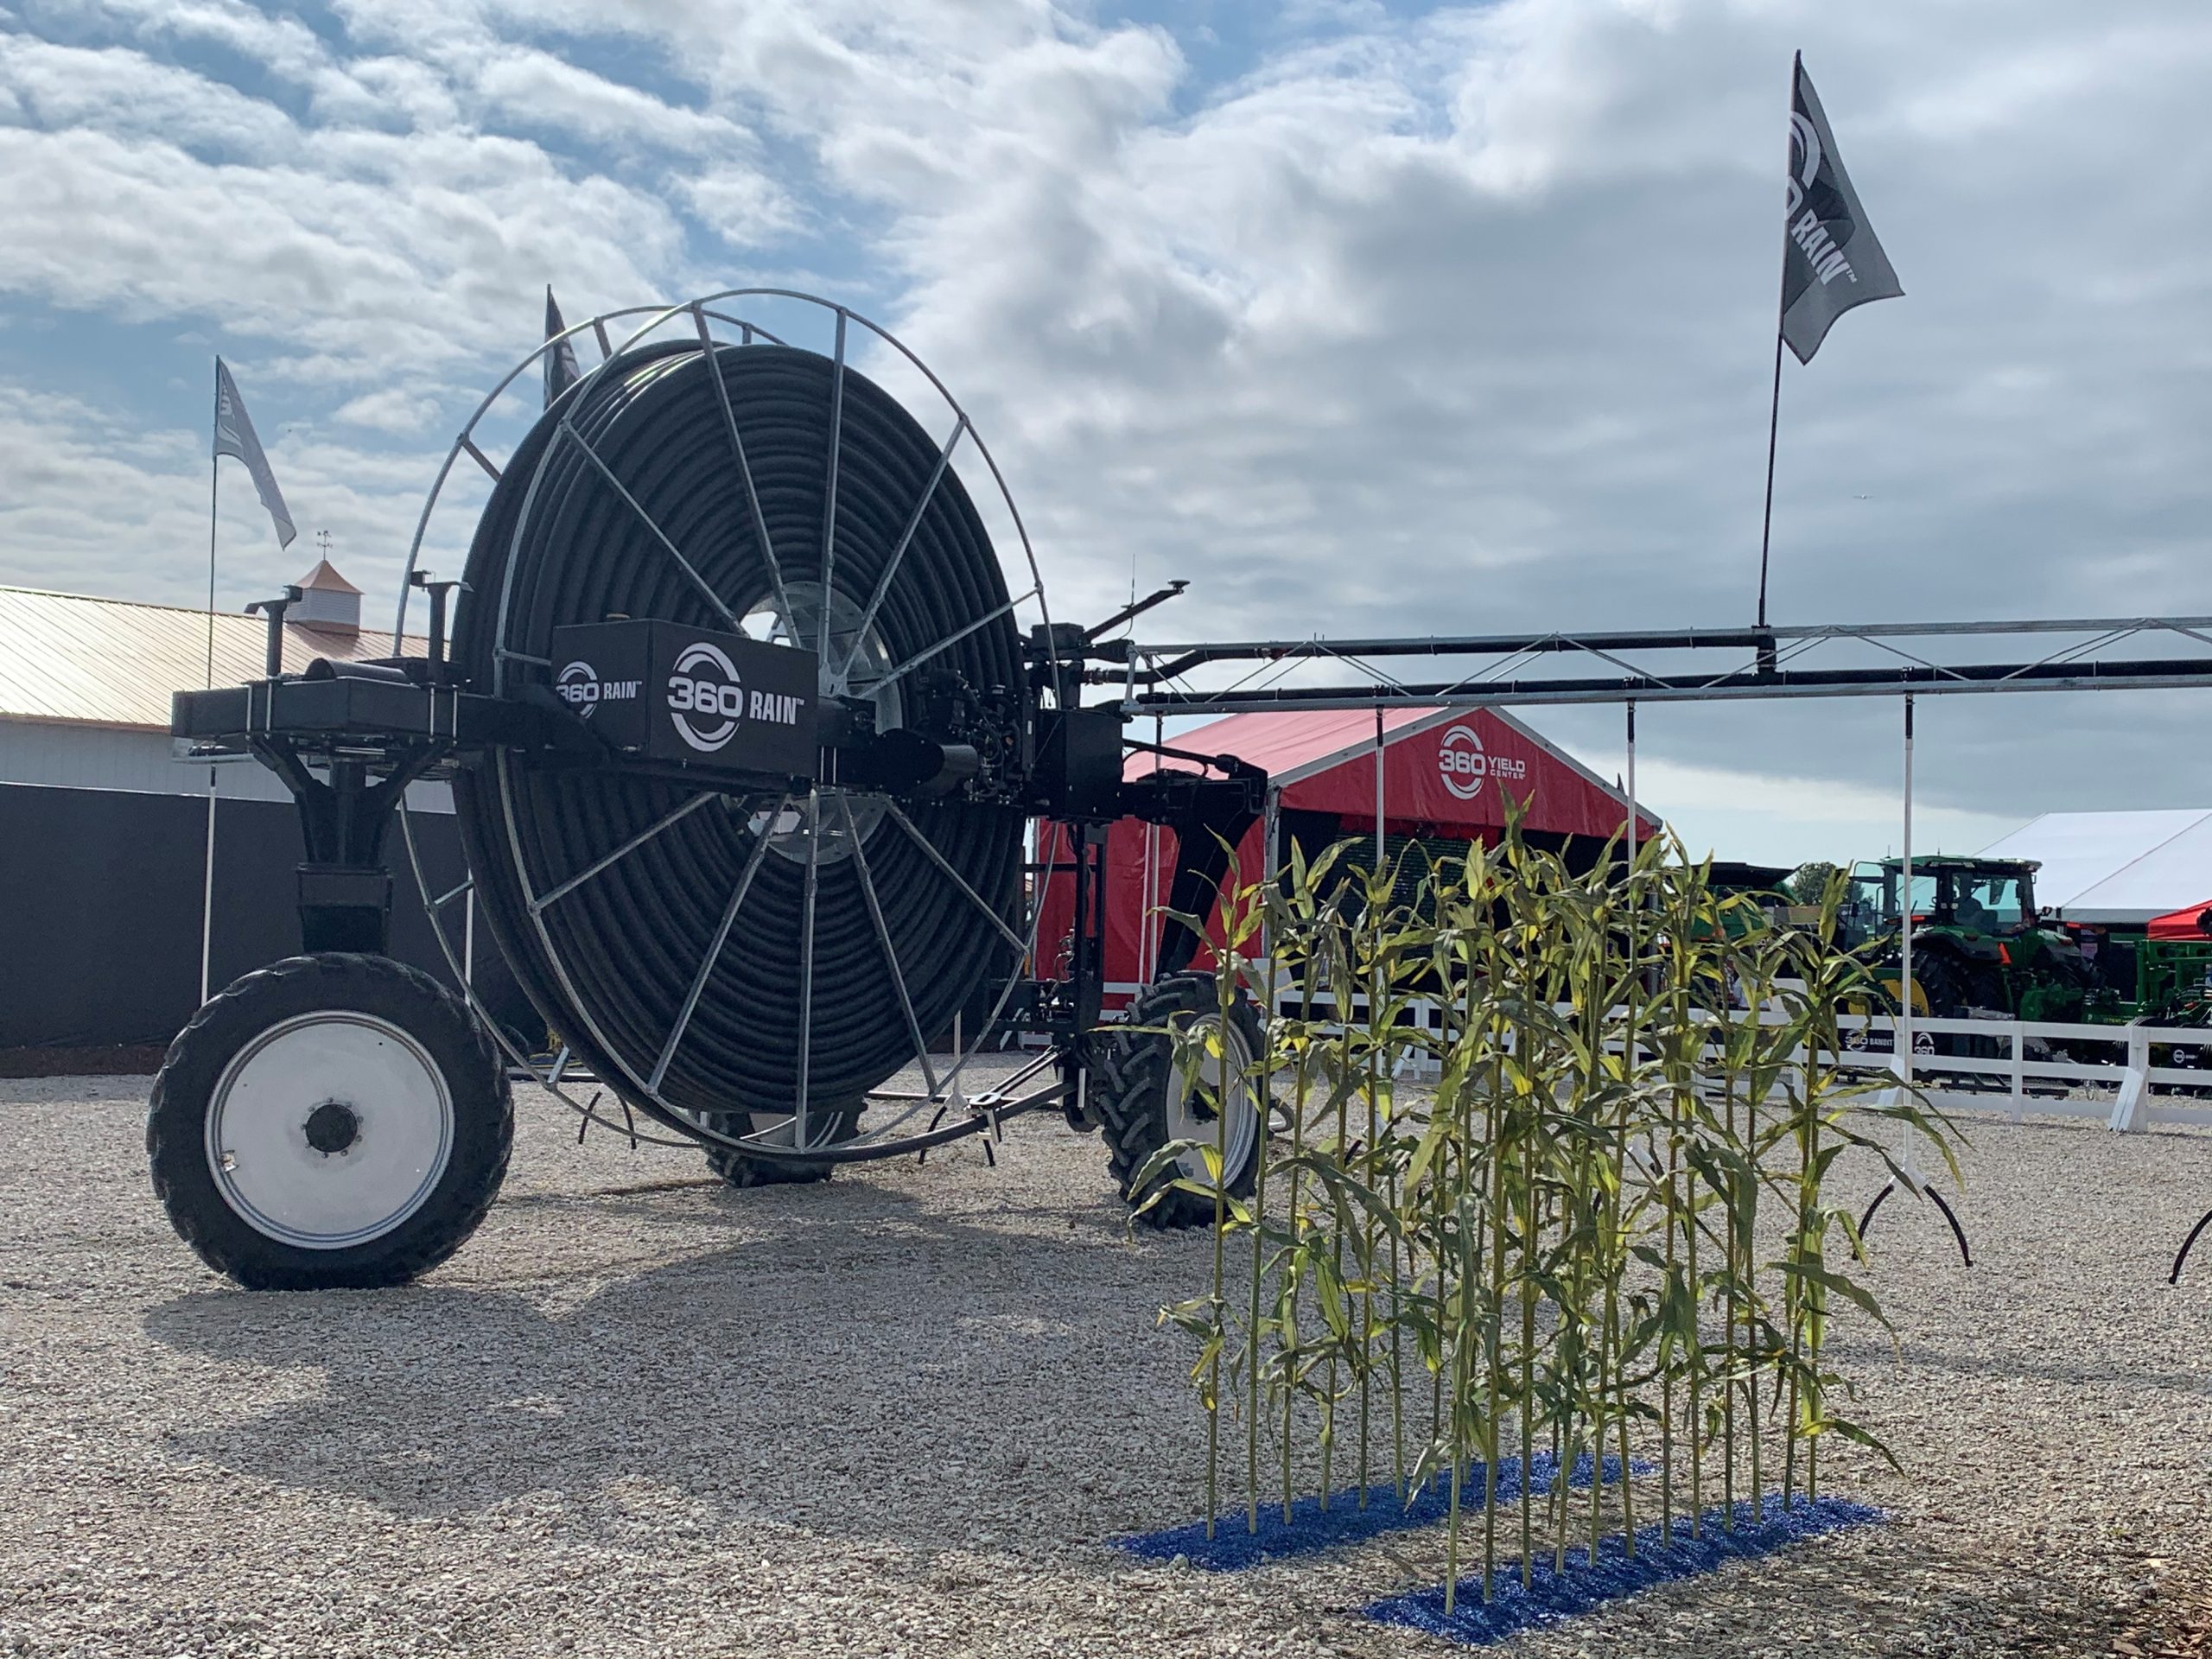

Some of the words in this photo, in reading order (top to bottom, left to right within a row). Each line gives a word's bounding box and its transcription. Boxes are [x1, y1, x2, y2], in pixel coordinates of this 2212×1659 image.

[667, 676, 744, 718] 360
[1438, 749, 1486, 775] 360
[1487, 755, 1526, 772] YIELD
